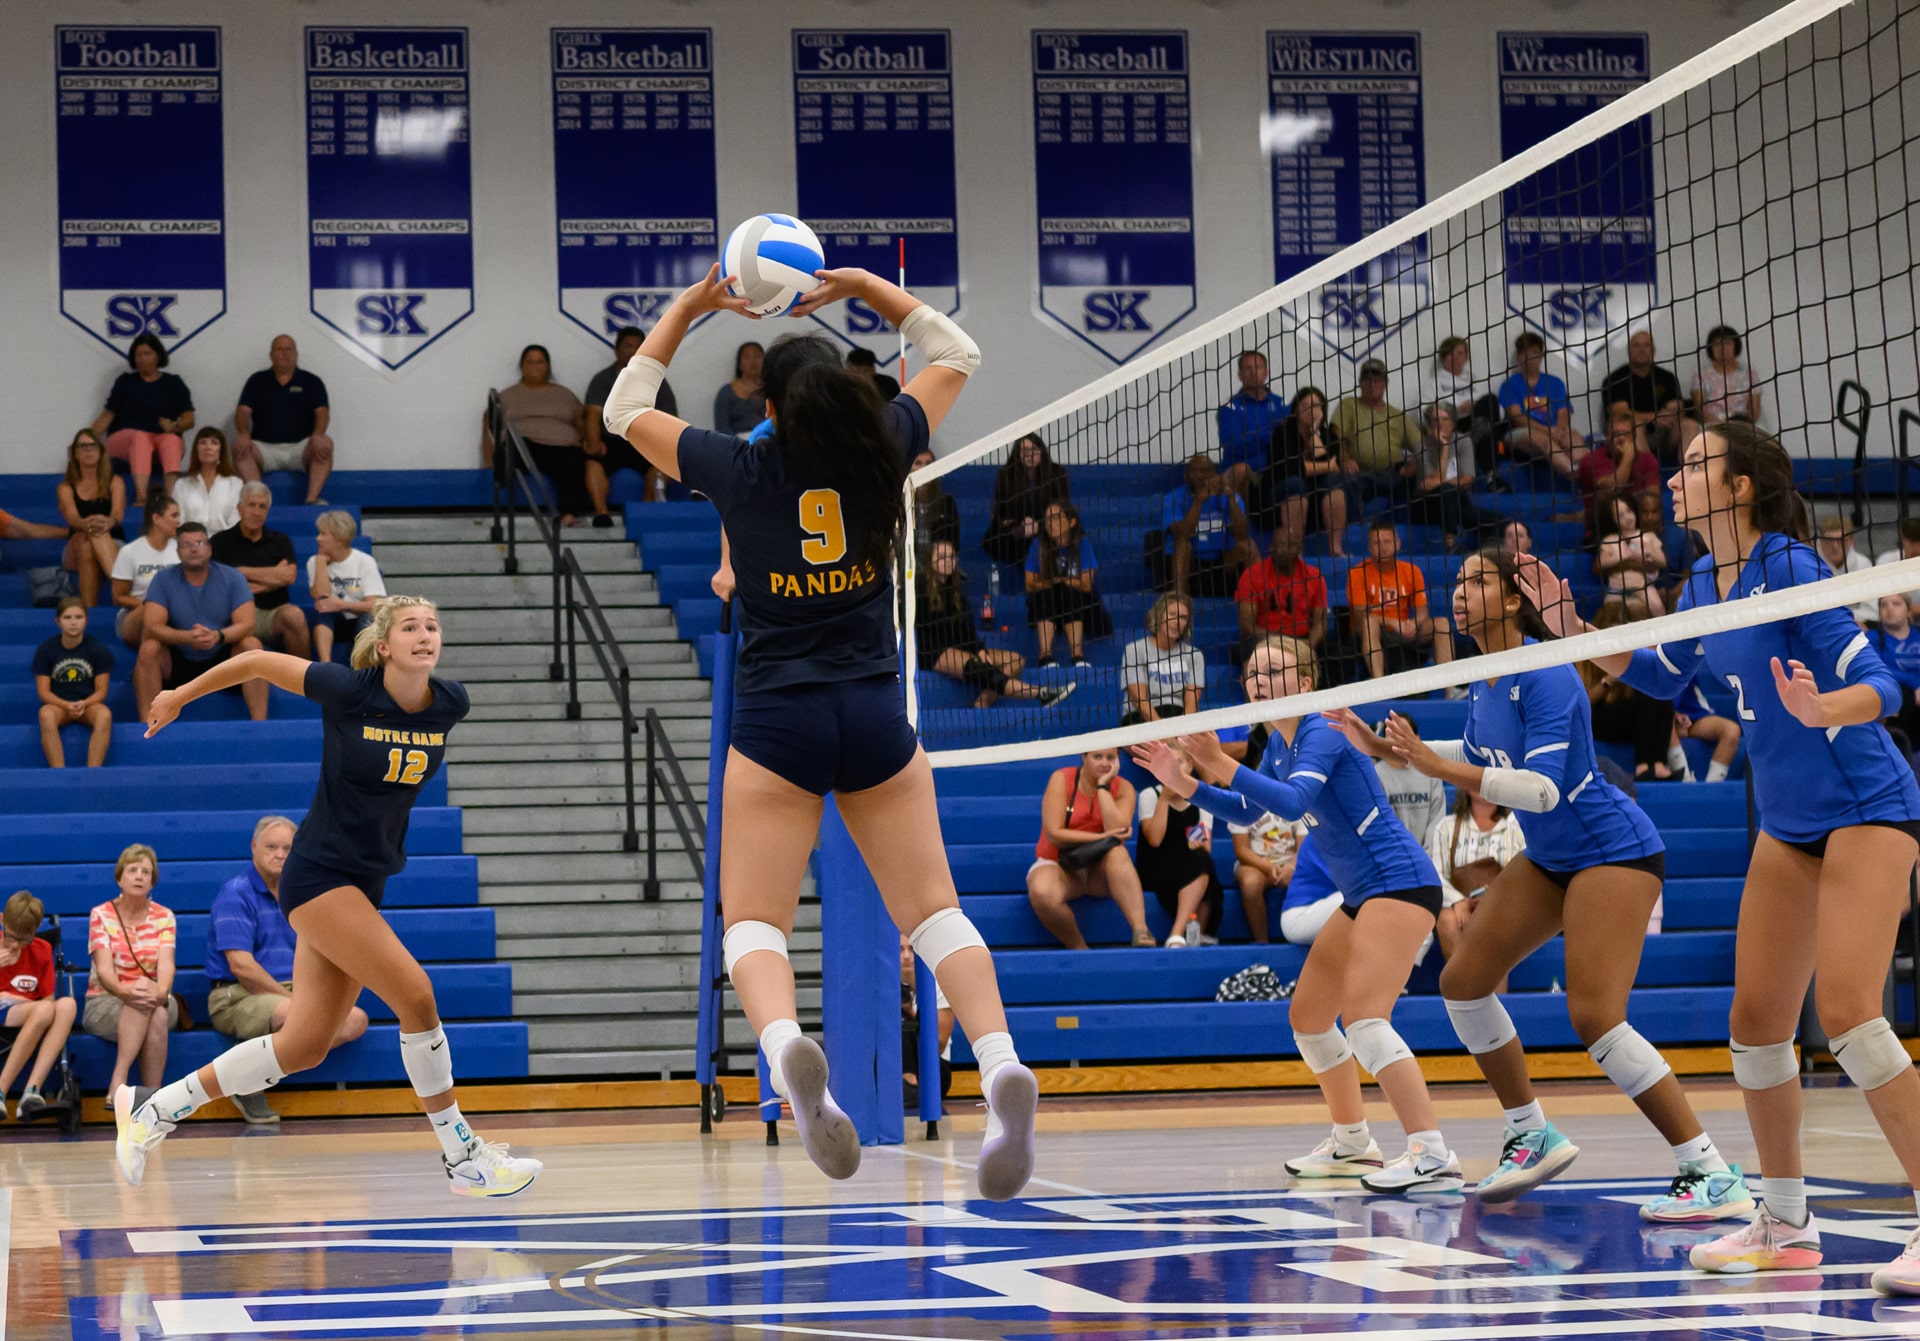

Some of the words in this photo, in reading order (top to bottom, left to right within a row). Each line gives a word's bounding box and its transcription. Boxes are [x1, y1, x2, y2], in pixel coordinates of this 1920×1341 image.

[65, 31, 106, 44] BOYS
[314, 32, 354, 45] BOYS
[558, 33, 602, 46] GIRLS
[801, 35, 845, 48] GIRLS
[1041, 35, 1080, 48] BOYS
[1274, 36, 1312, 49] BOYS
[1506, 37, 1544, 50] BOYS
[79, 43, 197, 67] Football
[315, 44, 460, 67] Basketball
[562, 44, 702, 68] Basketball
[818, 46, 926, 70] Softball
[1054, 47, 1168, 70] Baseball
[1275, 50, 1412, 71] WRESTLING
[1511, 49, 1637, 77] Wrestling
[63, 78, 137, 88] DISTRICT
[143, 78, 215, 88] CHAMPS
[312, 79, 387, 89] DISTRICT
[391, 79, 462, 89] CHAMPS
[559, 80, 635, 89] DISTRICT
[637, 80, 707, 89] CHAMPS
[800, 80, 875, 90] DISTRICT
[877, 80, 946, 90] CHAMPS
[1039, 80, 1110, 90] DISTRICT
[1115, 80, 1183, 90] CHAMPS
[1281, 81, 1332, 91] STATE
[1337, 81, 1410, 91] CHAMPS
[1506, 81, 1573, 91] DISTRICT
[65, 222, 144, 232] REGIONAL
[150, 222, 218, 232] CHAMPS
[315, 222, 394, 232] REGIONAL
[398, 222, 466, 232] CHAMPS
[563, 221, 640, 231] REGIONAL
[645, 221, 711, 231] CHAMPS
[885, 221, 950, 231] CHAMPS
[1044, 220, 1120, 230] REGIONAL
[1123, 220, 1187, 230] CHAMPS
[356, 293, 428, 337] SK
[1084, 291, 1153, 333] SK
[1321, 290, 1385, 329] SK
[1549, 289, 1613, 329] SK
[107, 294, 179, 338] SK
[799, 488, 847, 565] 9
[1725, 674, 1757, 722] 2
[363, 726, 411, 744] NOTRE
[383, 748, 428, 785] 12
